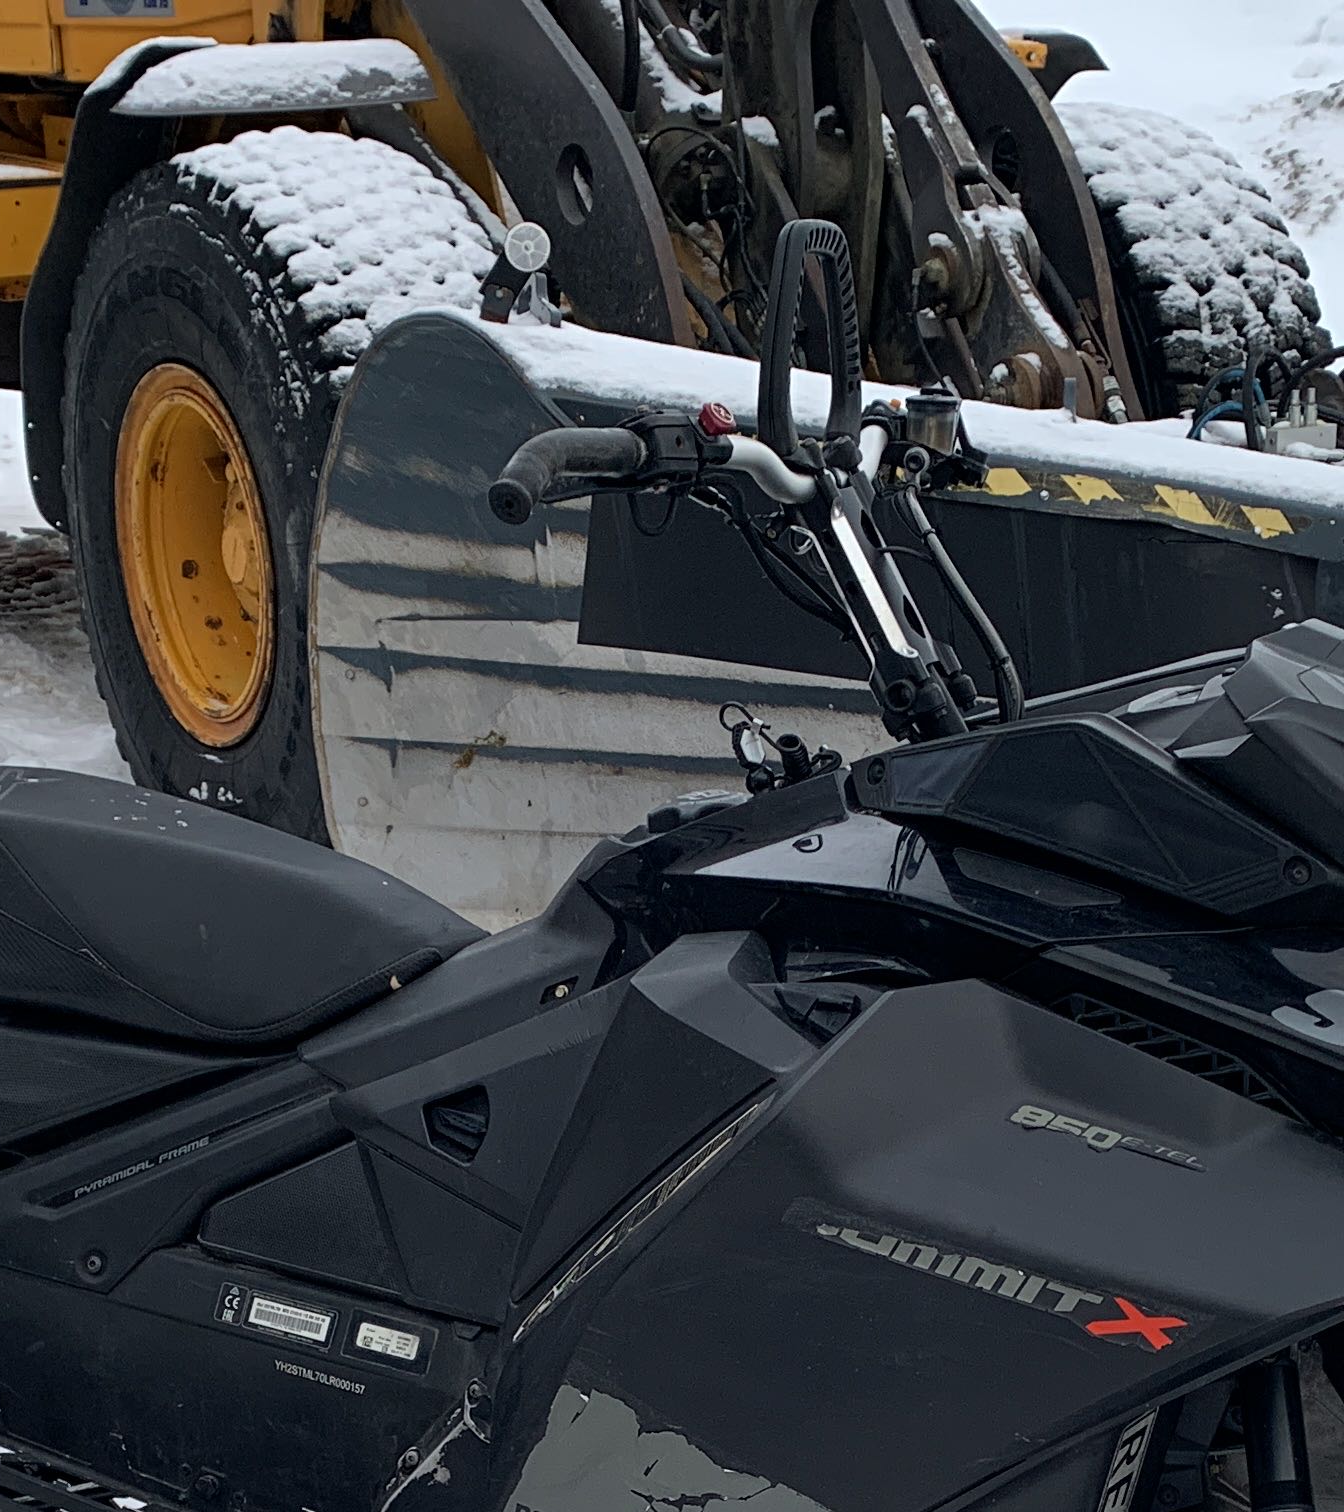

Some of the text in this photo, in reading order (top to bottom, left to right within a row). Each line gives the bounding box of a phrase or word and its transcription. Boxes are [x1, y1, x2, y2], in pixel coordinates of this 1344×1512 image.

[1010, 1105, 1122, 1150] 850
[74, 1135, 210, 1198] PYRAMIDAL FRAME
[816, 1223, 1188, 1350] UMMIT X
